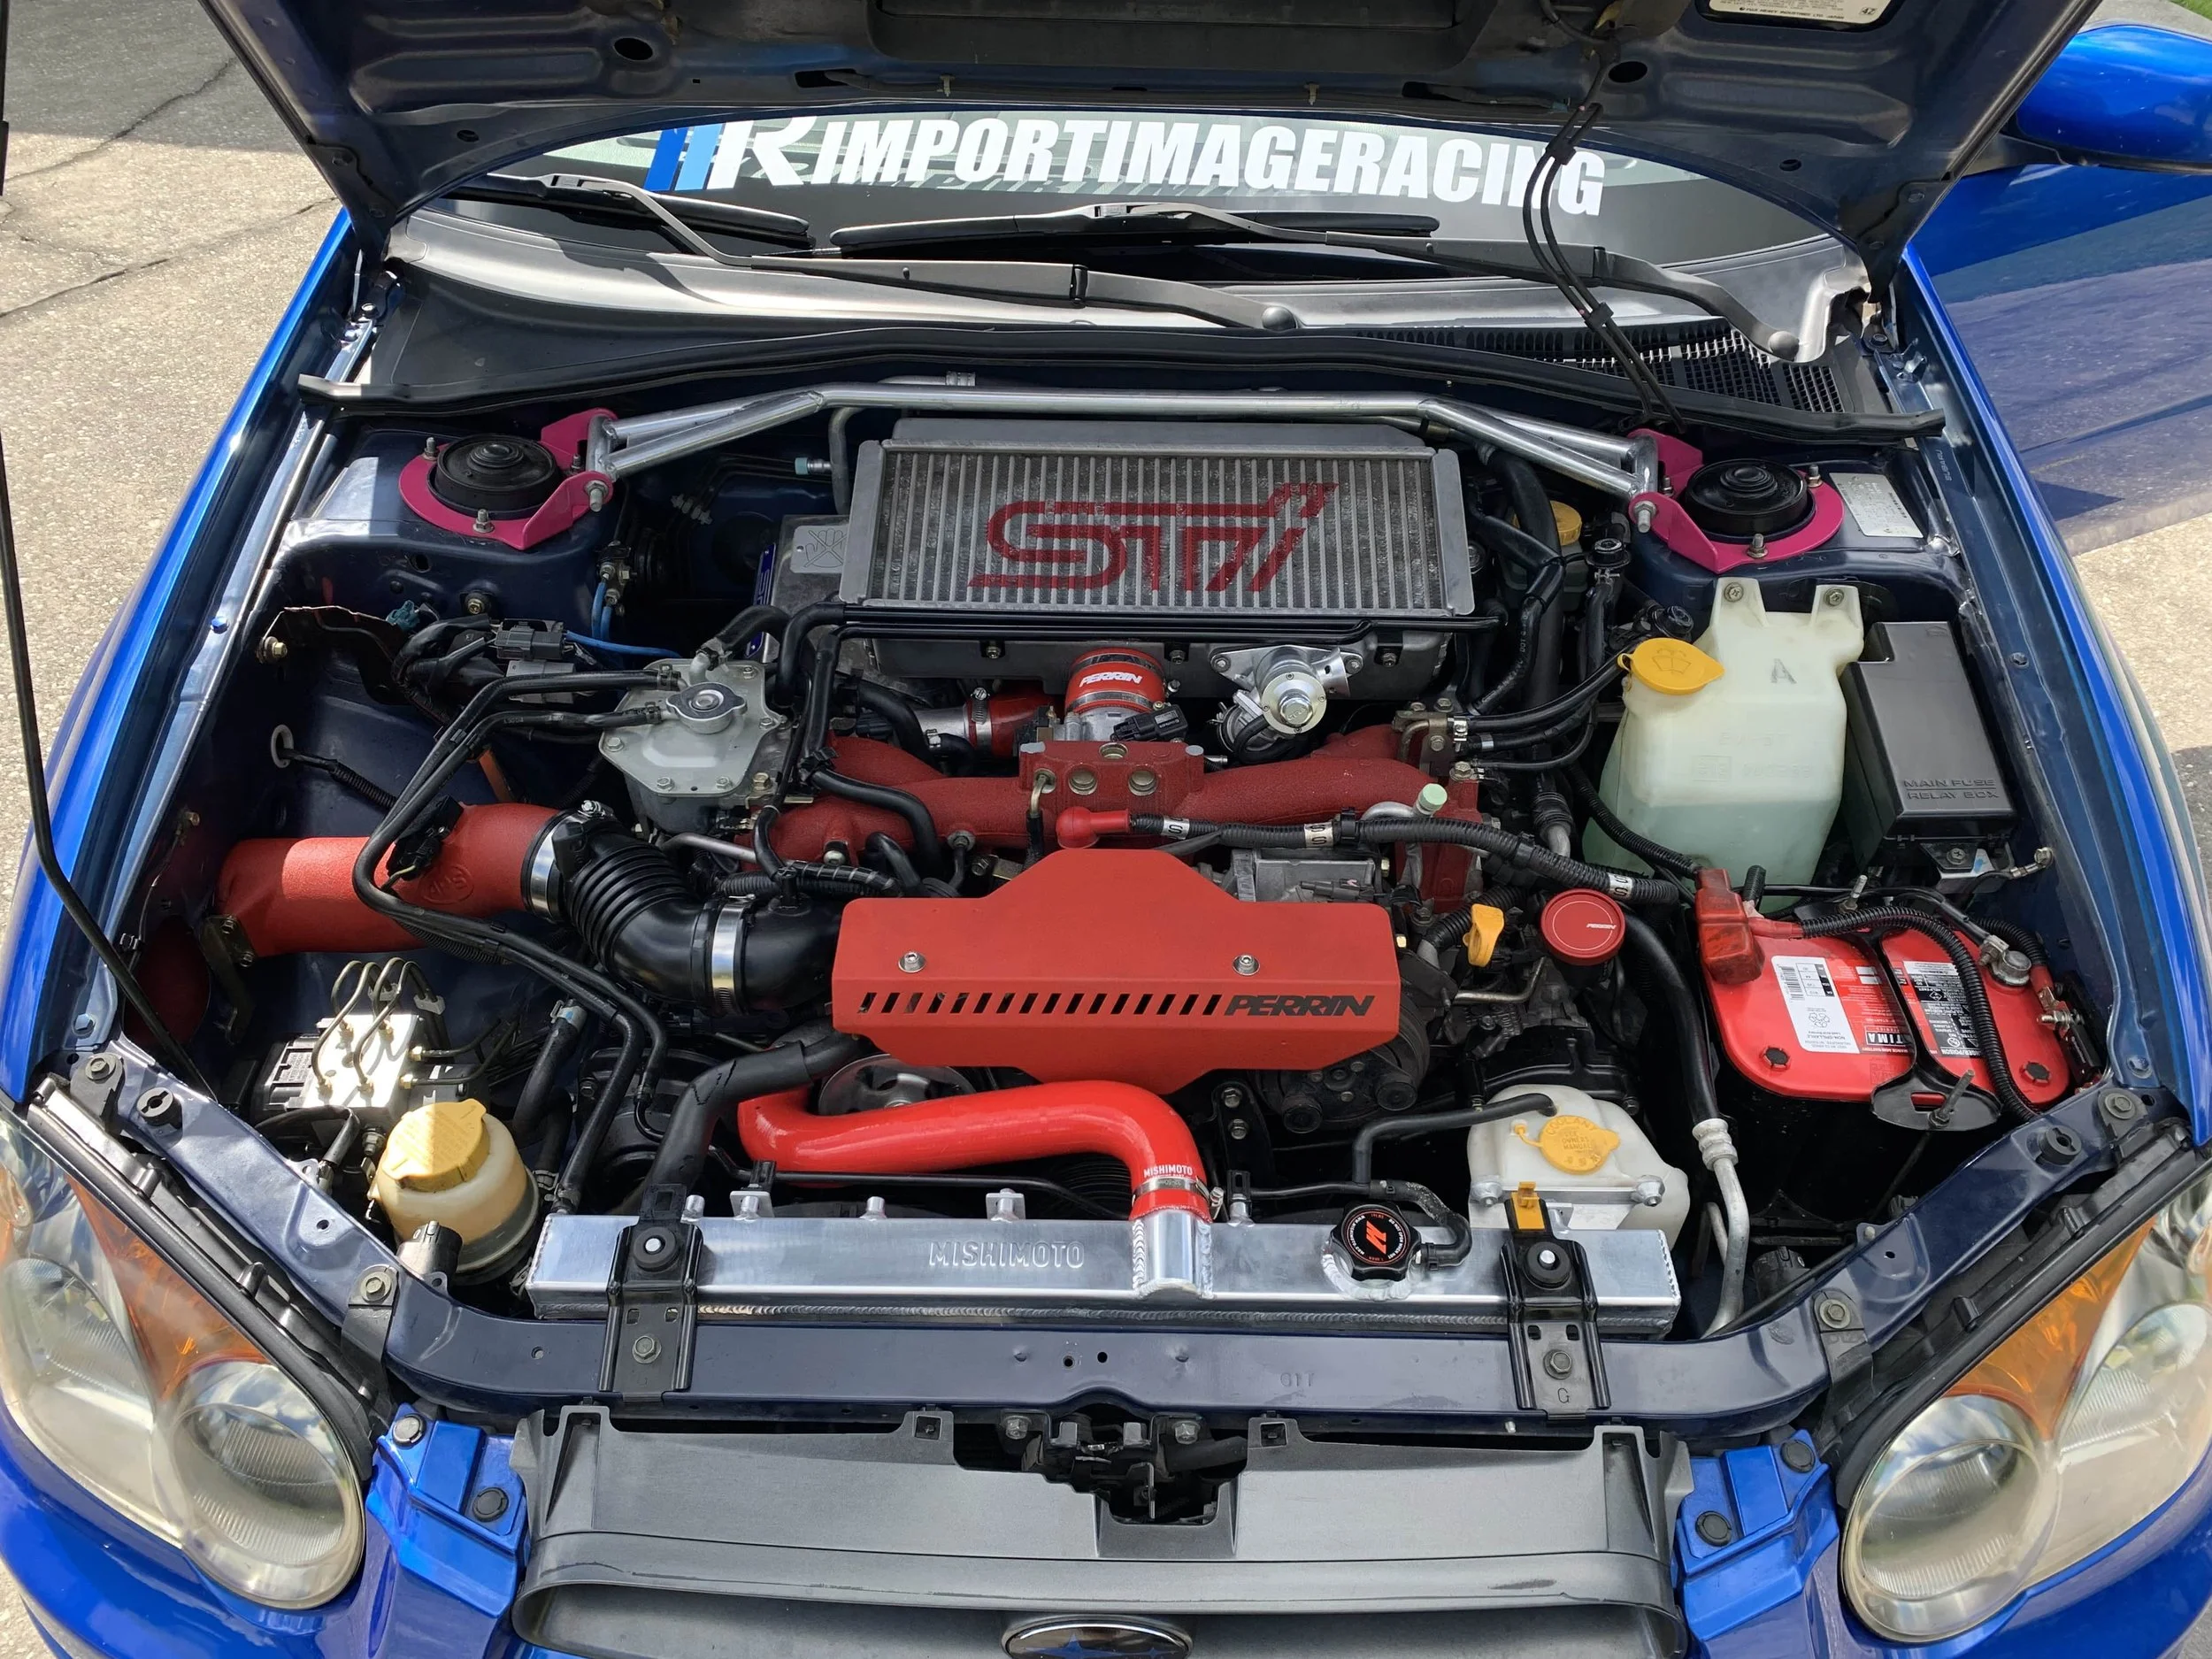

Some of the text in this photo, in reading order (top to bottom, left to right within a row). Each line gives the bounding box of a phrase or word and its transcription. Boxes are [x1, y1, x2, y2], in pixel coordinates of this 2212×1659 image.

[810, 118, 1606, 216] IMPORTIMAGERACING
[1770, 657, 1797, 684] A
[1079, 672, 1143, 687] PERRIN
[1903, 779, 1947, 787] MAIN
[1907, 791, 1957, 800] RELAY
[1224, 994, 1376, 1017] PERRIN
[1867, 1033, 1904, 1044] TIMA
[1143, 1164, 1194, 1179] MISHIMOTO
[928, 1240, 1085, 1269] MISHIMOTO
